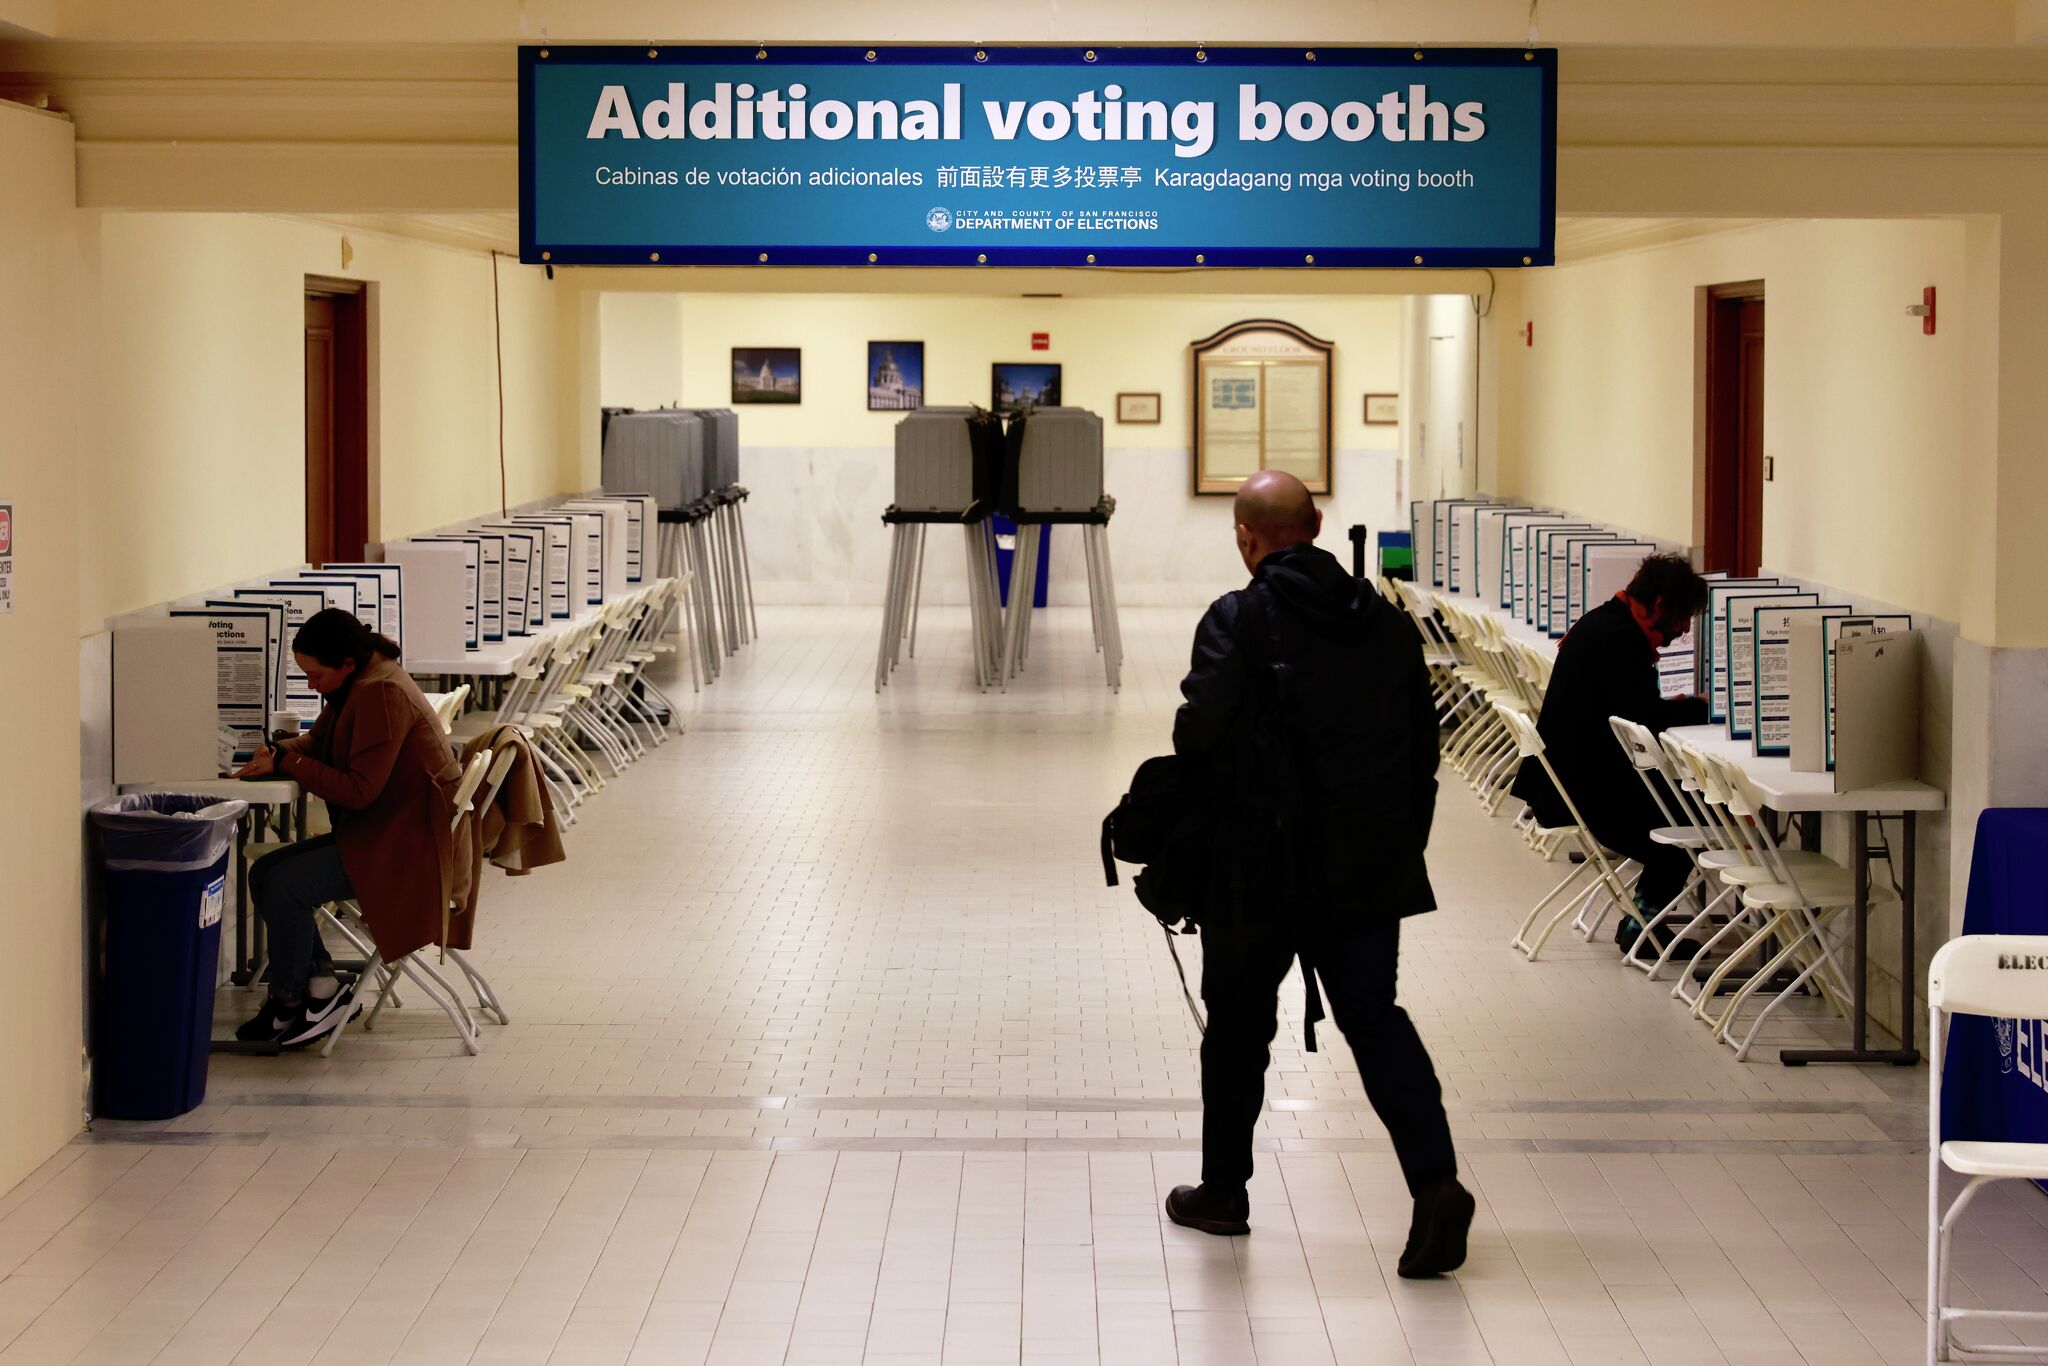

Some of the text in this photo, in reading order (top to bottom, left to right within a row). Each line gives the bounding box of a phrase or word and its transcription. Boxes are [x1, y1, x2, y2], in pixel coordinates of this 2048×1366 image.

[586, 82, 1486, 158] Additional voting booths
[595, 167, 923, 186] Cabinas de votación adicionales
[936, 165, 1142, 189] 前面設有更多投票亭
[1155, 169, 1474, 192] Karagdagang mga voting booth
[956, 218, 1053, 229] DEPARTMENT
[1055, 218, 1075, 229] OF
[1077, 218, 1159, 230] ELECTIONS
